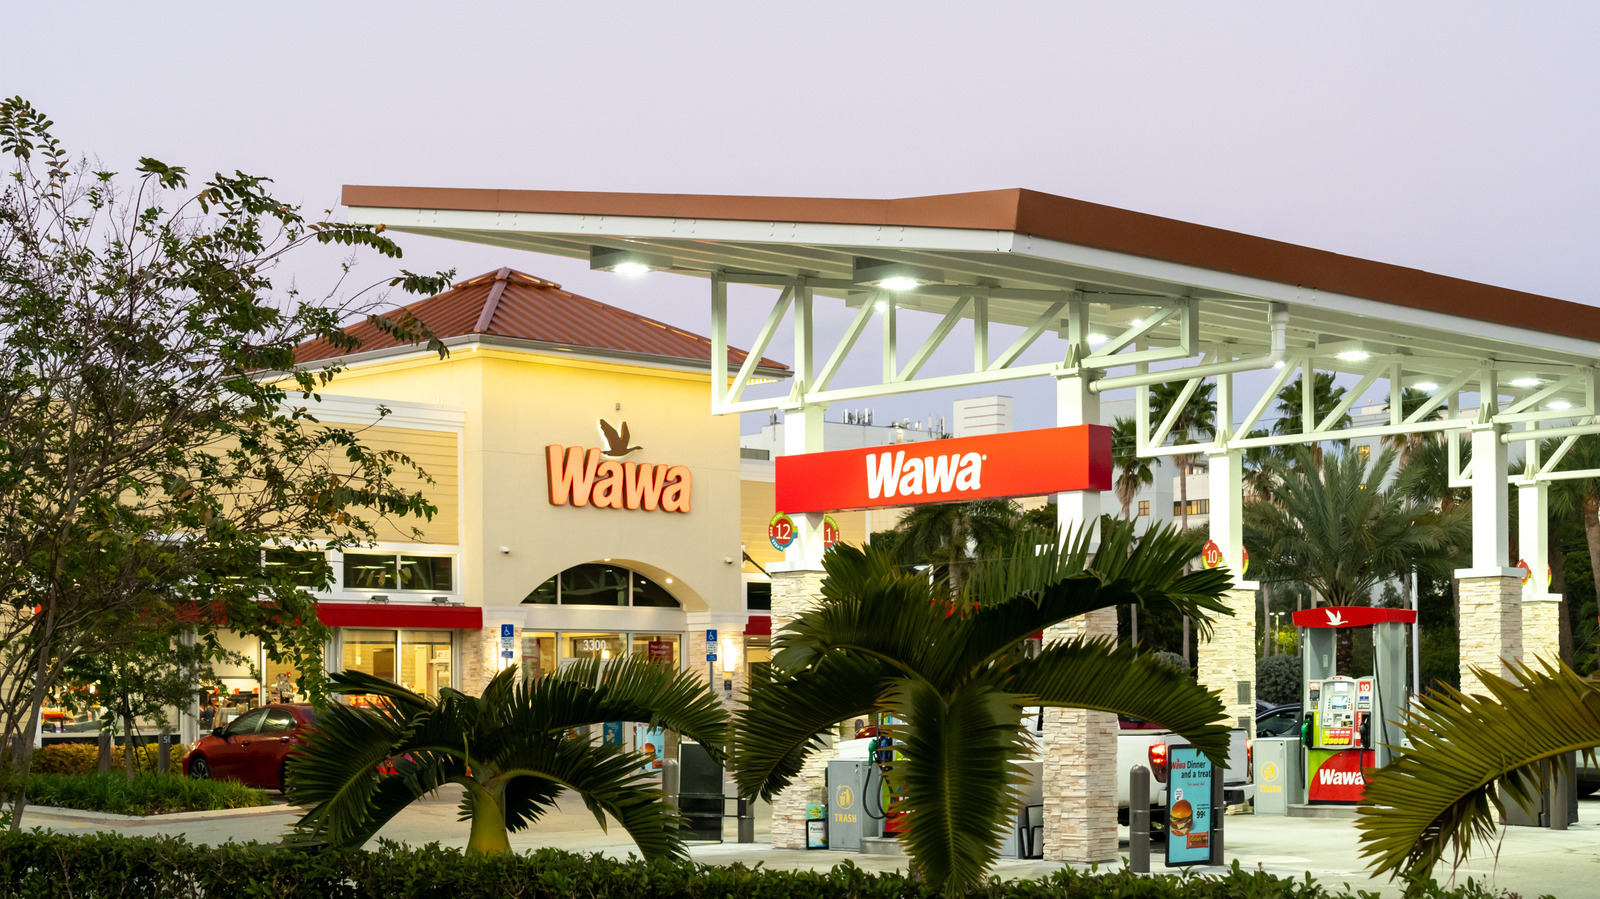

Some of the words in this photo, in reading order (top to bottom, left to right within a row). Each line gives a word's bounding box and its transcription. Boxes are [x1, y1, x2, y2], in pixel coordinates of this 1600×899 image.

[546, 444, 692, 513] Wawa
[866, 451, 982, 499] Wawa
[776, 524, 791, 540] 12
[824, 528, 833, 543] 1
[1207, 550, 1218, 564] 10
[583, 639, 607, 651] 3300
[1360, 684, 1370, 692] 10
[1187, 760, 1206, 769] Dinner
[1181, 770, 1191, 778] and
[1198, 770, 1211, 778] treat
[1319, 769, 1364, 785] Wawa
[1260, 785, 1281, 793] TRASH
[835, 813, 857, 823] TRASH
